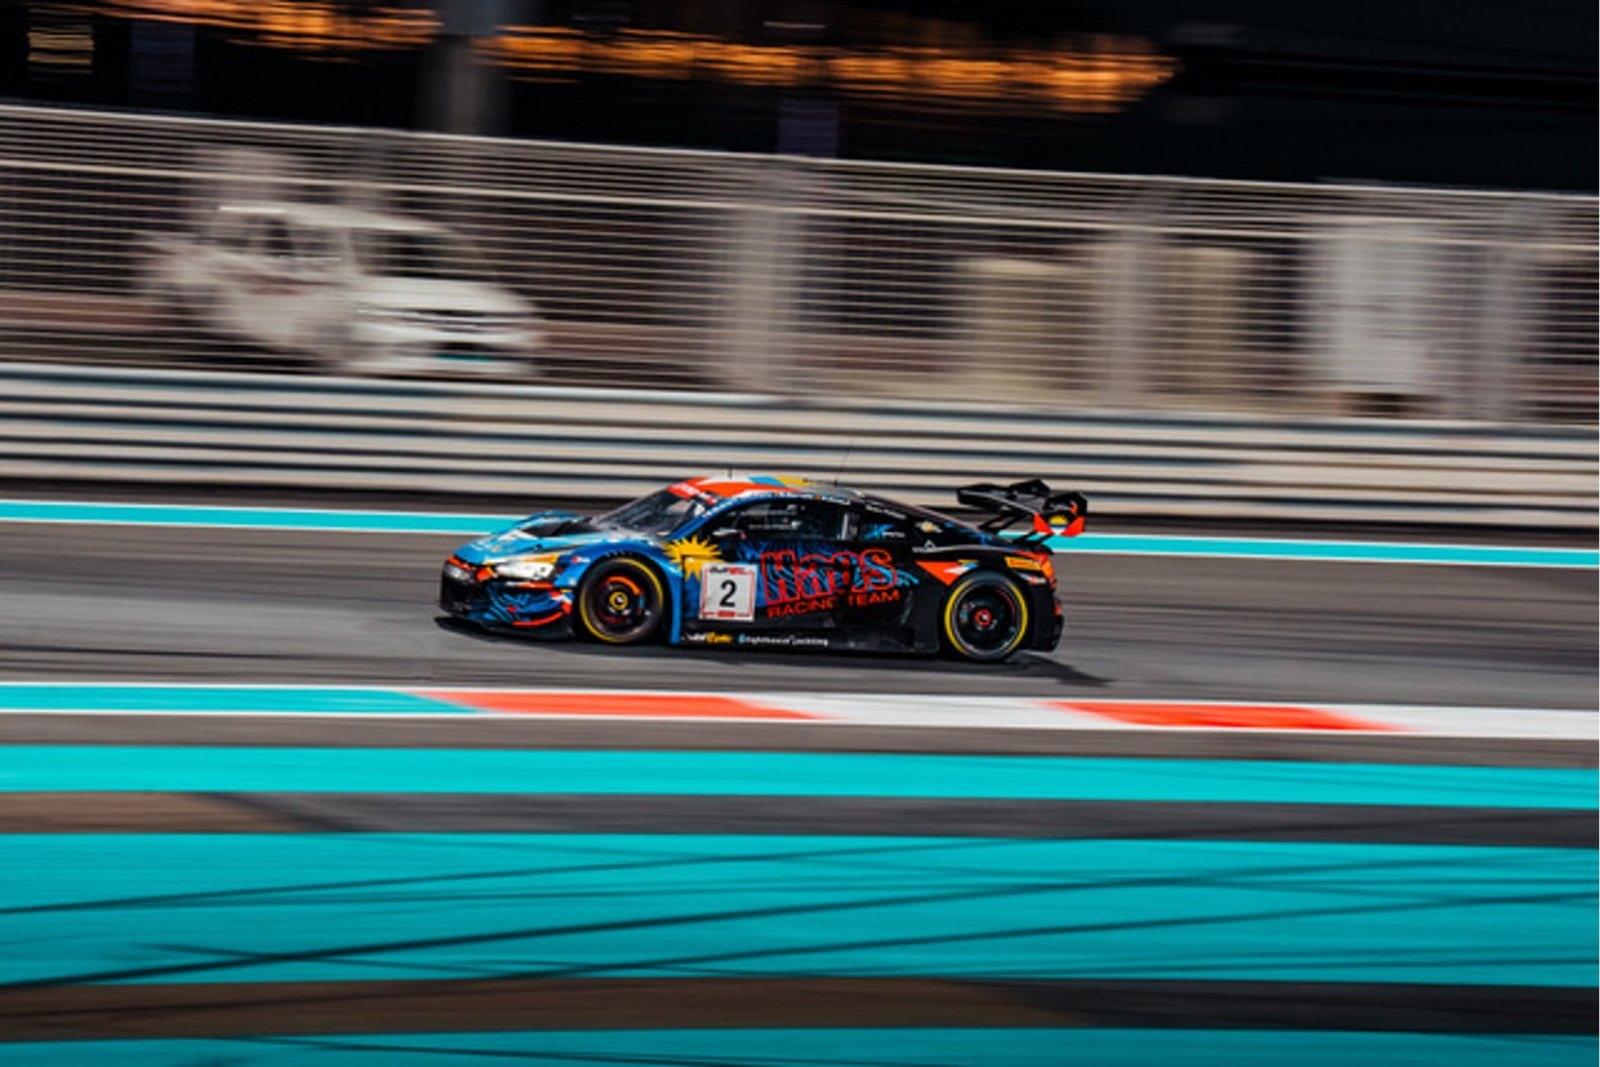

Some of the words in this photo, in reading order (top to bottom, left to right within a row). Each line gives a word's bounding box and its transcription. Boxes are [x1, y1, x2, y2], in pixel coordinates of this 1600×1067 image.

[719, 579, 737, 607] 2
[767, 597, 838, 618] RACING
[848, 590, 901, 607] TEAM
